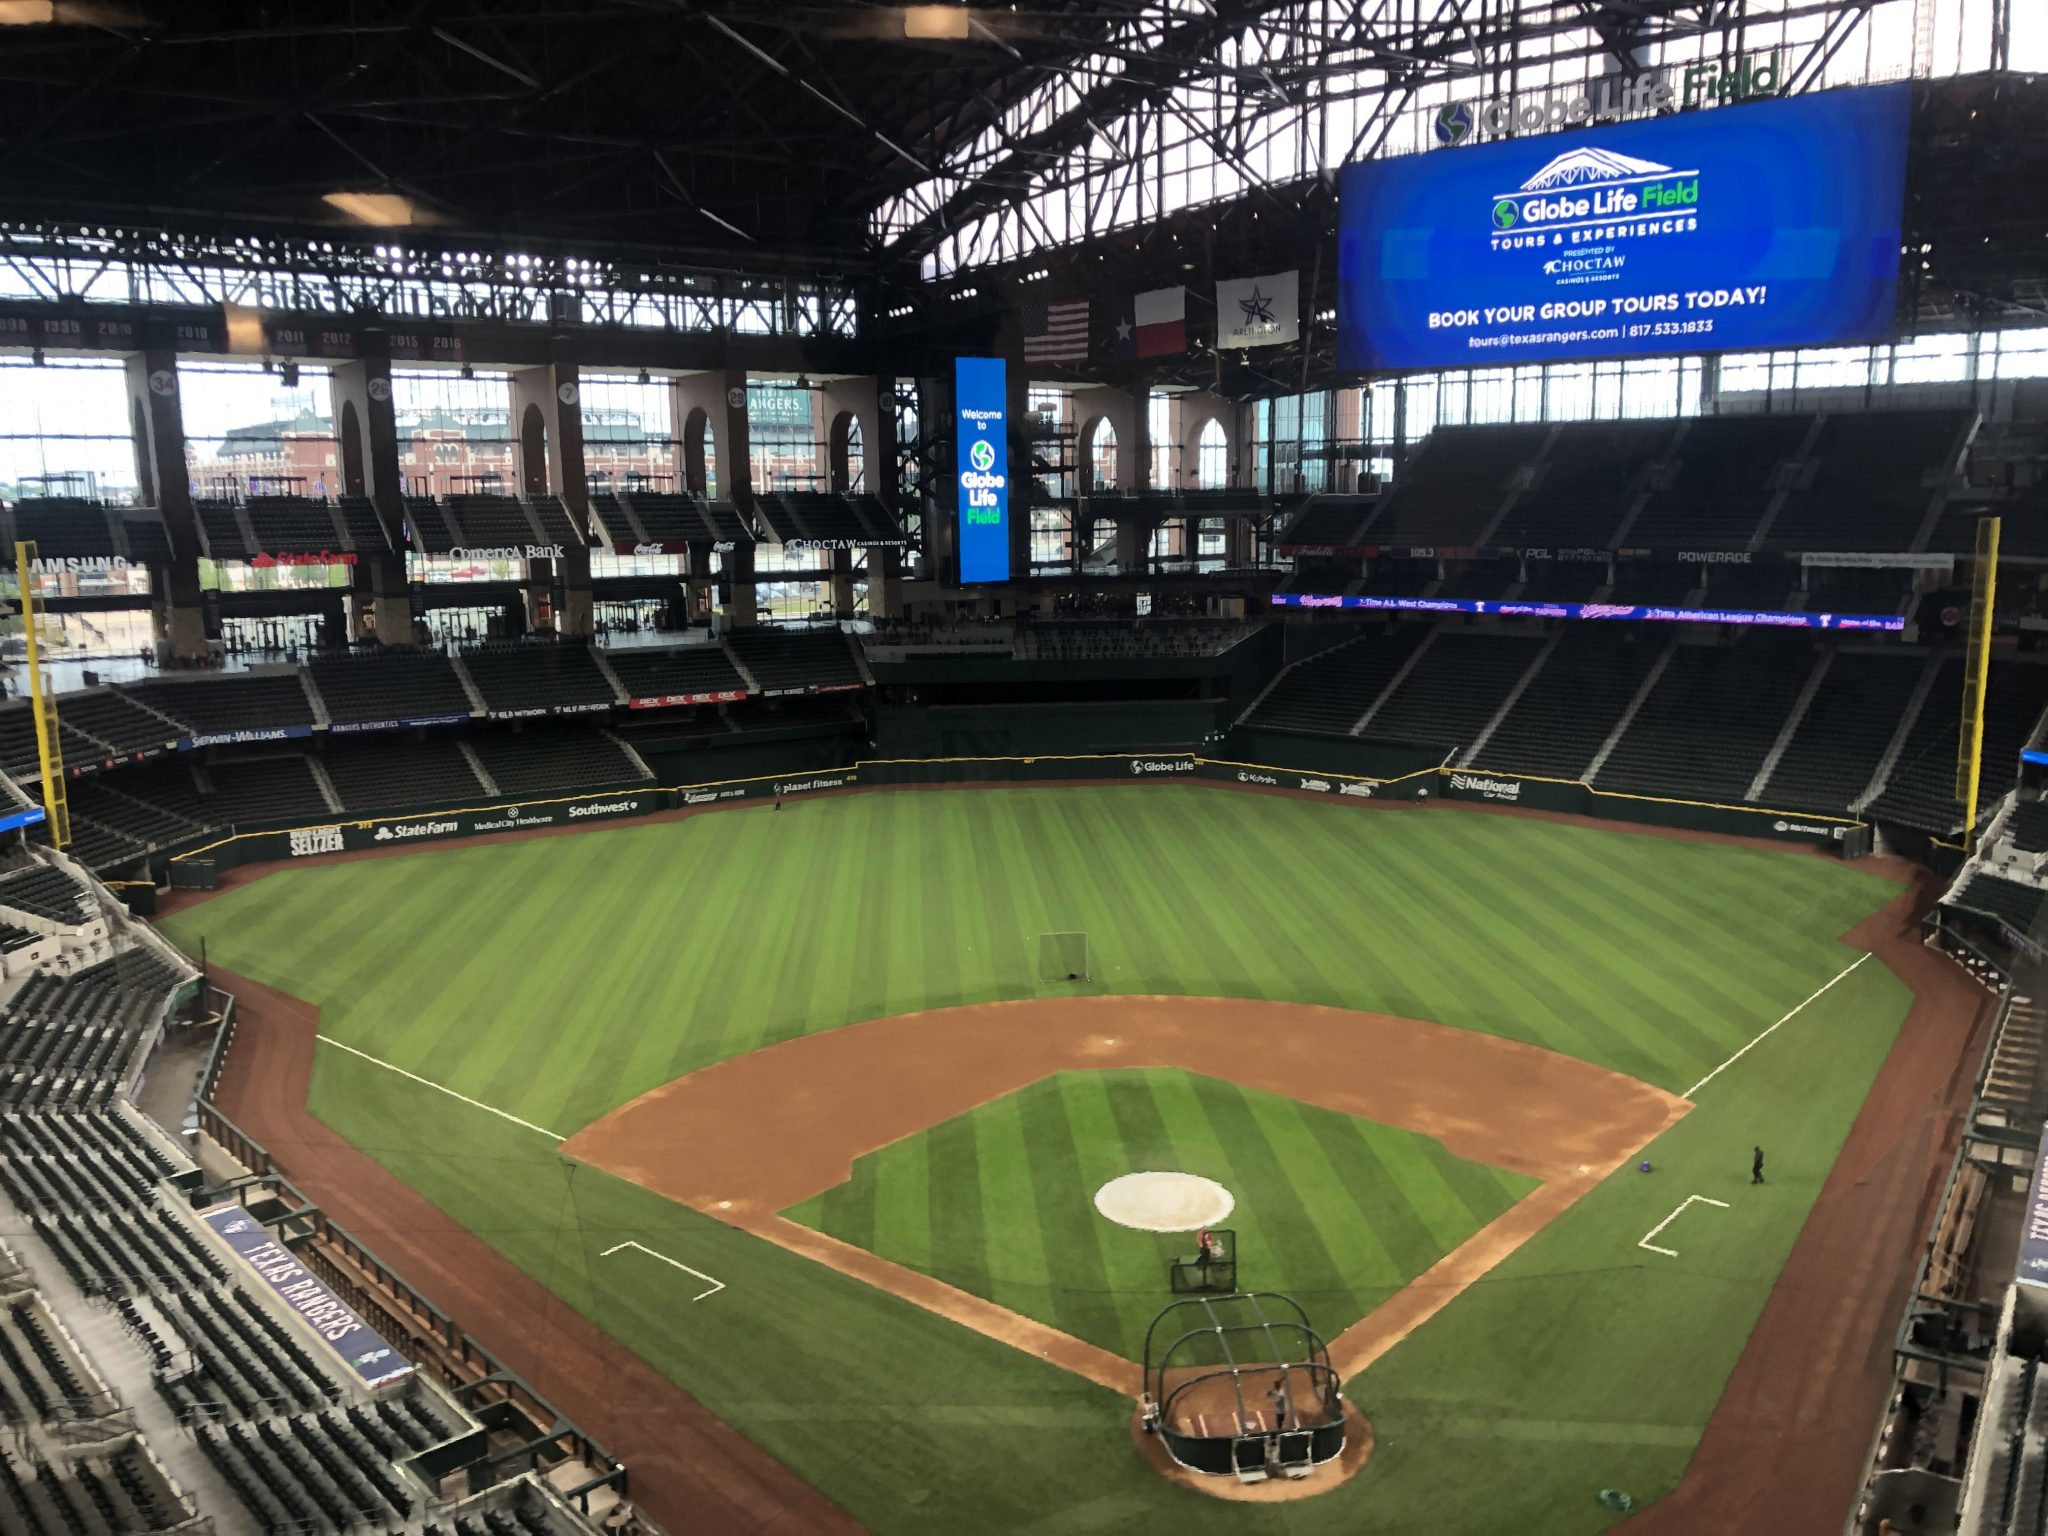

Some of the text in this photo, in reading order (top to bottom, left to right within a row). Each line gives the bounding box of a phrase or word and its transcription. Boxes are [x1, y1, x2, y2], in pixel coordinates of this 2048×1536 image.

[1482, 50, 1781, 135] Globe Life Field
[1522, 179, 1699, 223] Globe Life Field
[1490, 218, 1698, 251] TOURS & EXPERIENCES
[1563, 245, 1616, 257] PRESENTED BY
[1552, 255, 1626, 273] CHOCTAW
[1428, 286, 1767, 329] BOOK YOUR GROUP TOURS TODAY!
[1469, 319, 1714, 348] tours@texasrangers.com 817.533.1833
[730, 392, 744, 404] 29
[749, 398, 800, 410] ANGERS
[962, 408, 1002, 420] Welcome
[977, 421, 987, 430] to
[961, 471, 1005, 488] Globe
[970, 489, 998, 506] Life
[967, 506, 1001, 524] Field
[524, 544, 565, 559] Bank
[793, 538, 857, 550] CHOCTAW
[17, 555, 128, 574] AMSUNG
[1677, 551, 1752, 564] POWERADE
[1144, 762, 1174, 772] Globe
[1175, 761, 1194, 771] Life
[783, 779, 843, 794] planet fitness
[1465, 776, 1521, 794] National
[568, 801, 629, 818] Southwest
[474, 820, 501, 831] Medical
[516, 816, 553, 826] Healthcare
[243, 1241, 363, 1342] TEXAS RANGERS
